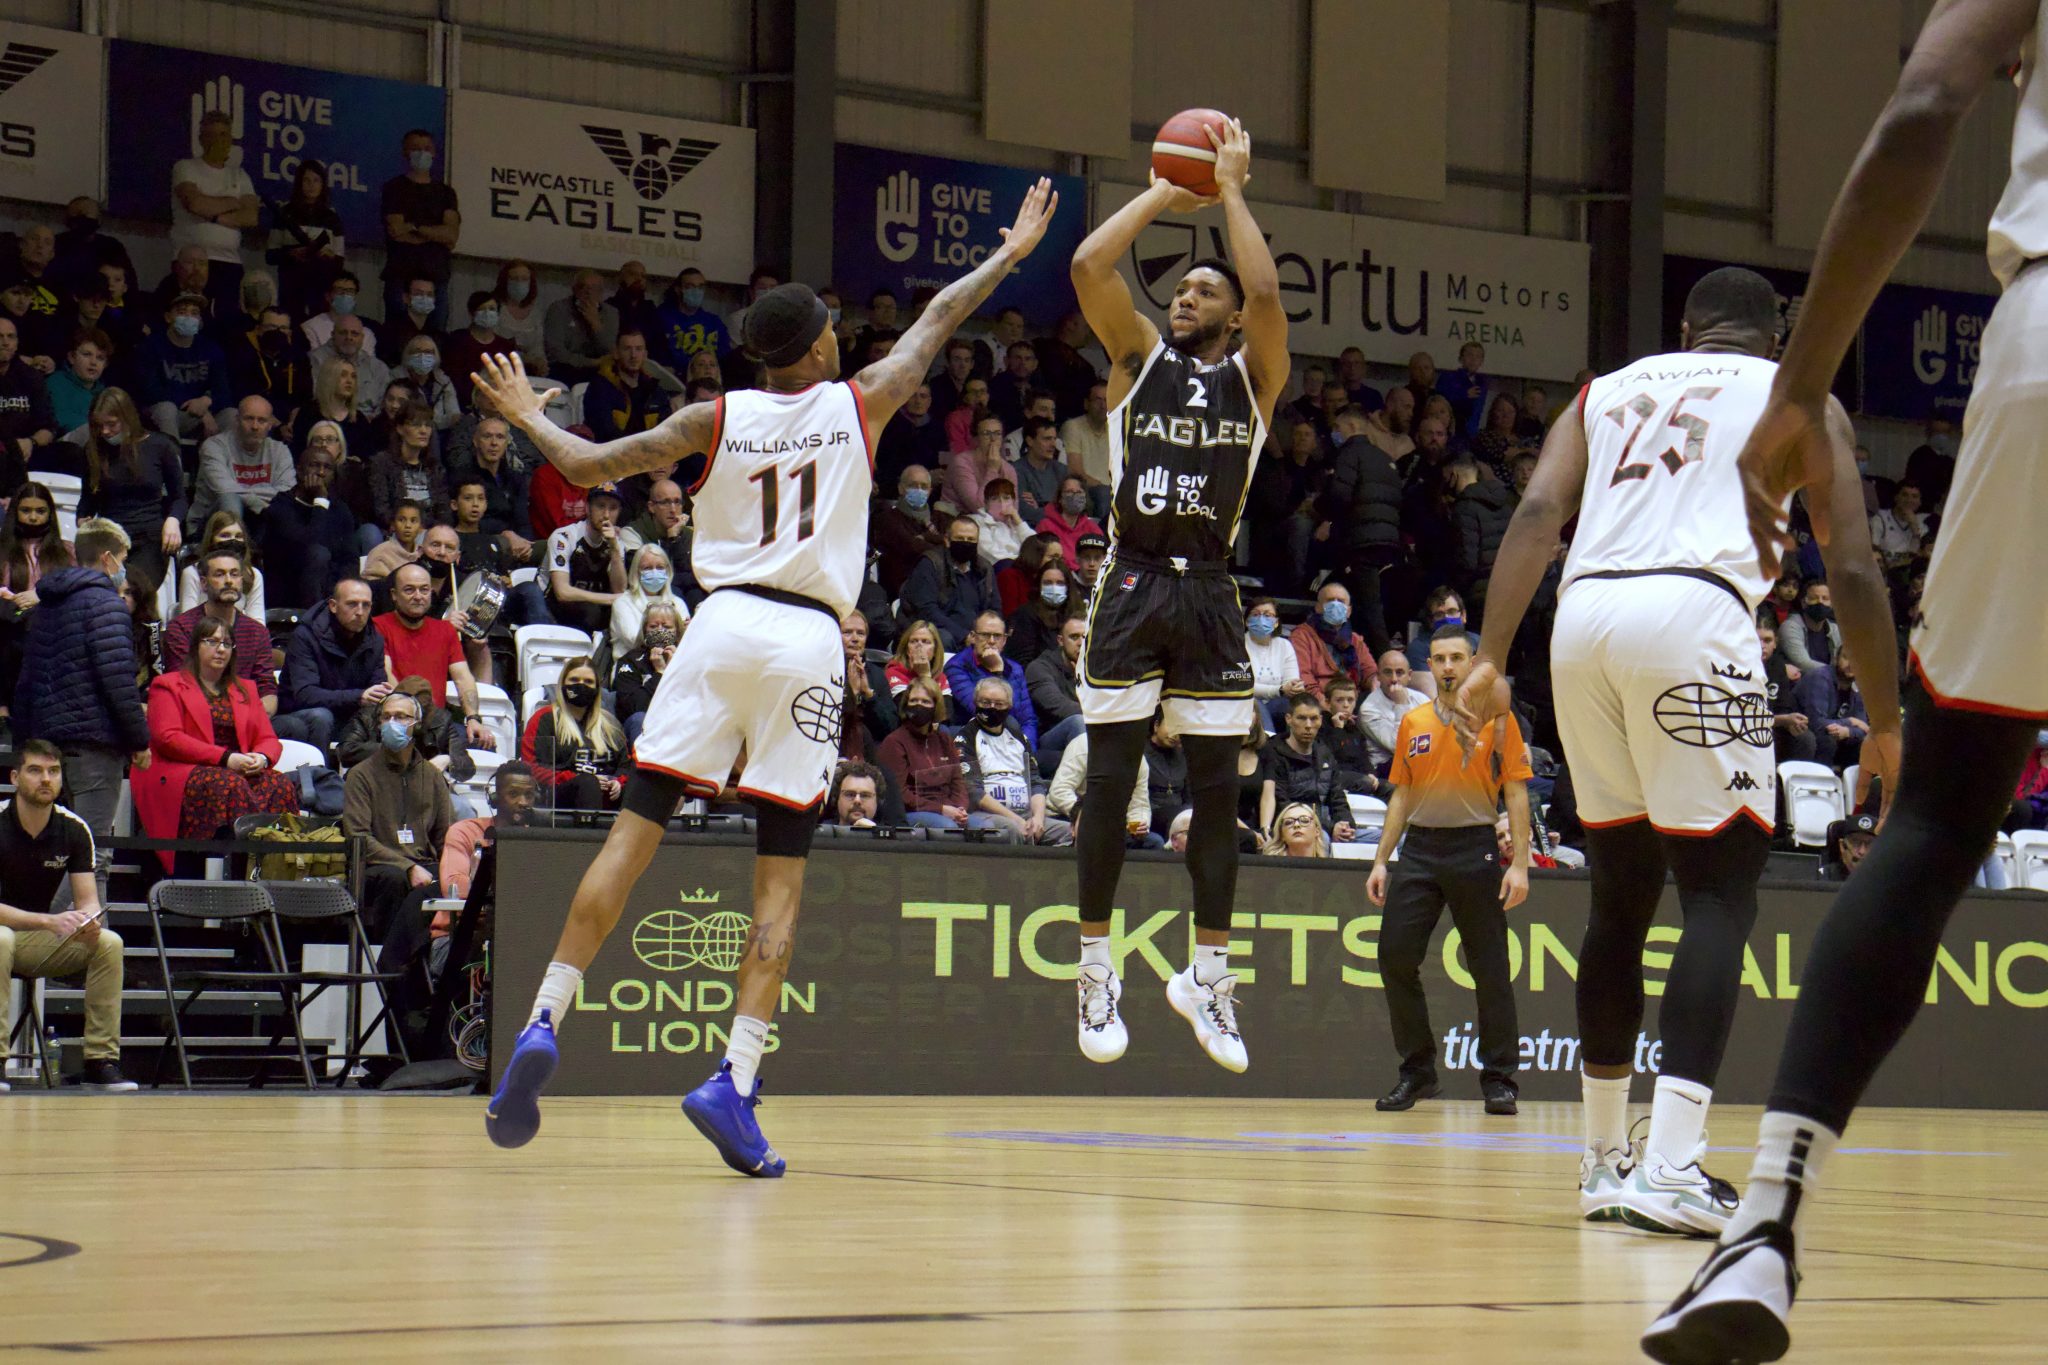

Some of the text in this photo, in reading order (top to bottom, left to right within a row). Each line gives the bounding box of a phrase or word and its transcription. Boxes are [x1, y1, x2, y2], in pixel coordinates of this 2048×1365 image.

[259, 90, 333, 126] GIVE
[260, 120, 305, 153] TO
[263, 152, 368, 193] LOAL
[490, 166, 615, 197] NEWCASTLE
[489, 186, 704, 242] EAGLES
[931, 182, 993, 215] GIVE
[931, 210, 970, 239] TO
[933, 239, 1020, 274] LOC
[1447, 273, 1570, 312] Motors
[1448, 319, 1525, 348] ARENA
[1185, 377, 1209, 408] 2
[1614, 367, 1742, 388] TAWIAH
[725, 431, 850, 454] WILLIAMS JR
[1604, 386, 1725, 489] 25
[1176, 474, 1209, 489] GIV
[1176, 487, 1200, 502] TO
[747, 458, 817, 549] 11
[902, 901, 1386, 989] TICKETS
[1442, 922, 1579, 992] ON
[1924, 940, 2048, 1009] NO
[575, 979, 817, 1015] LONDN
